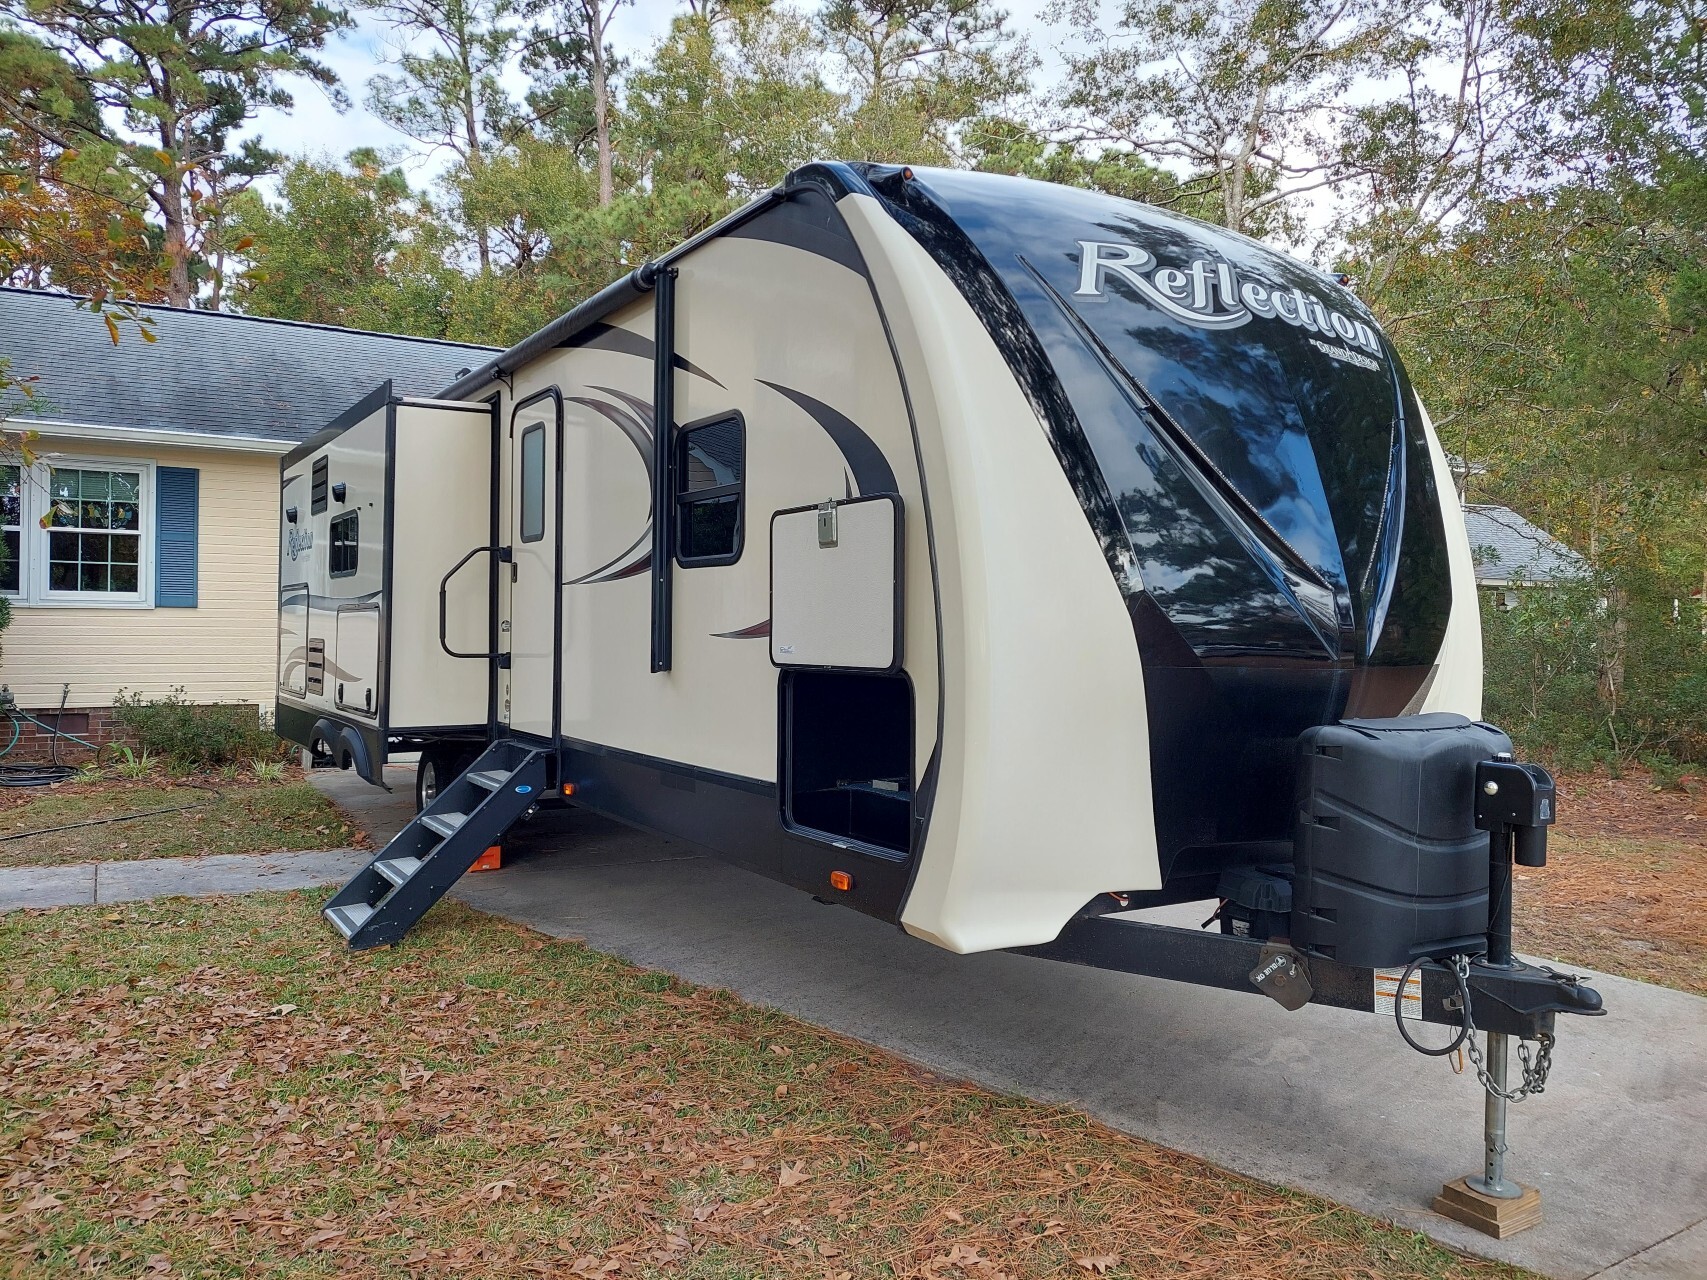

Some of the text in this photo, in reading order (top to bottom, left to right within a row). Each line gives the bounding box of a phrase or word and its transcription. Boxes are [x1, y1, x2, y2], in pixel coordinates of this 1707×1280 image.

[1072, 239, 1383, 357] Reflection
[1255, 962, 1278, 983] BLUE OX
